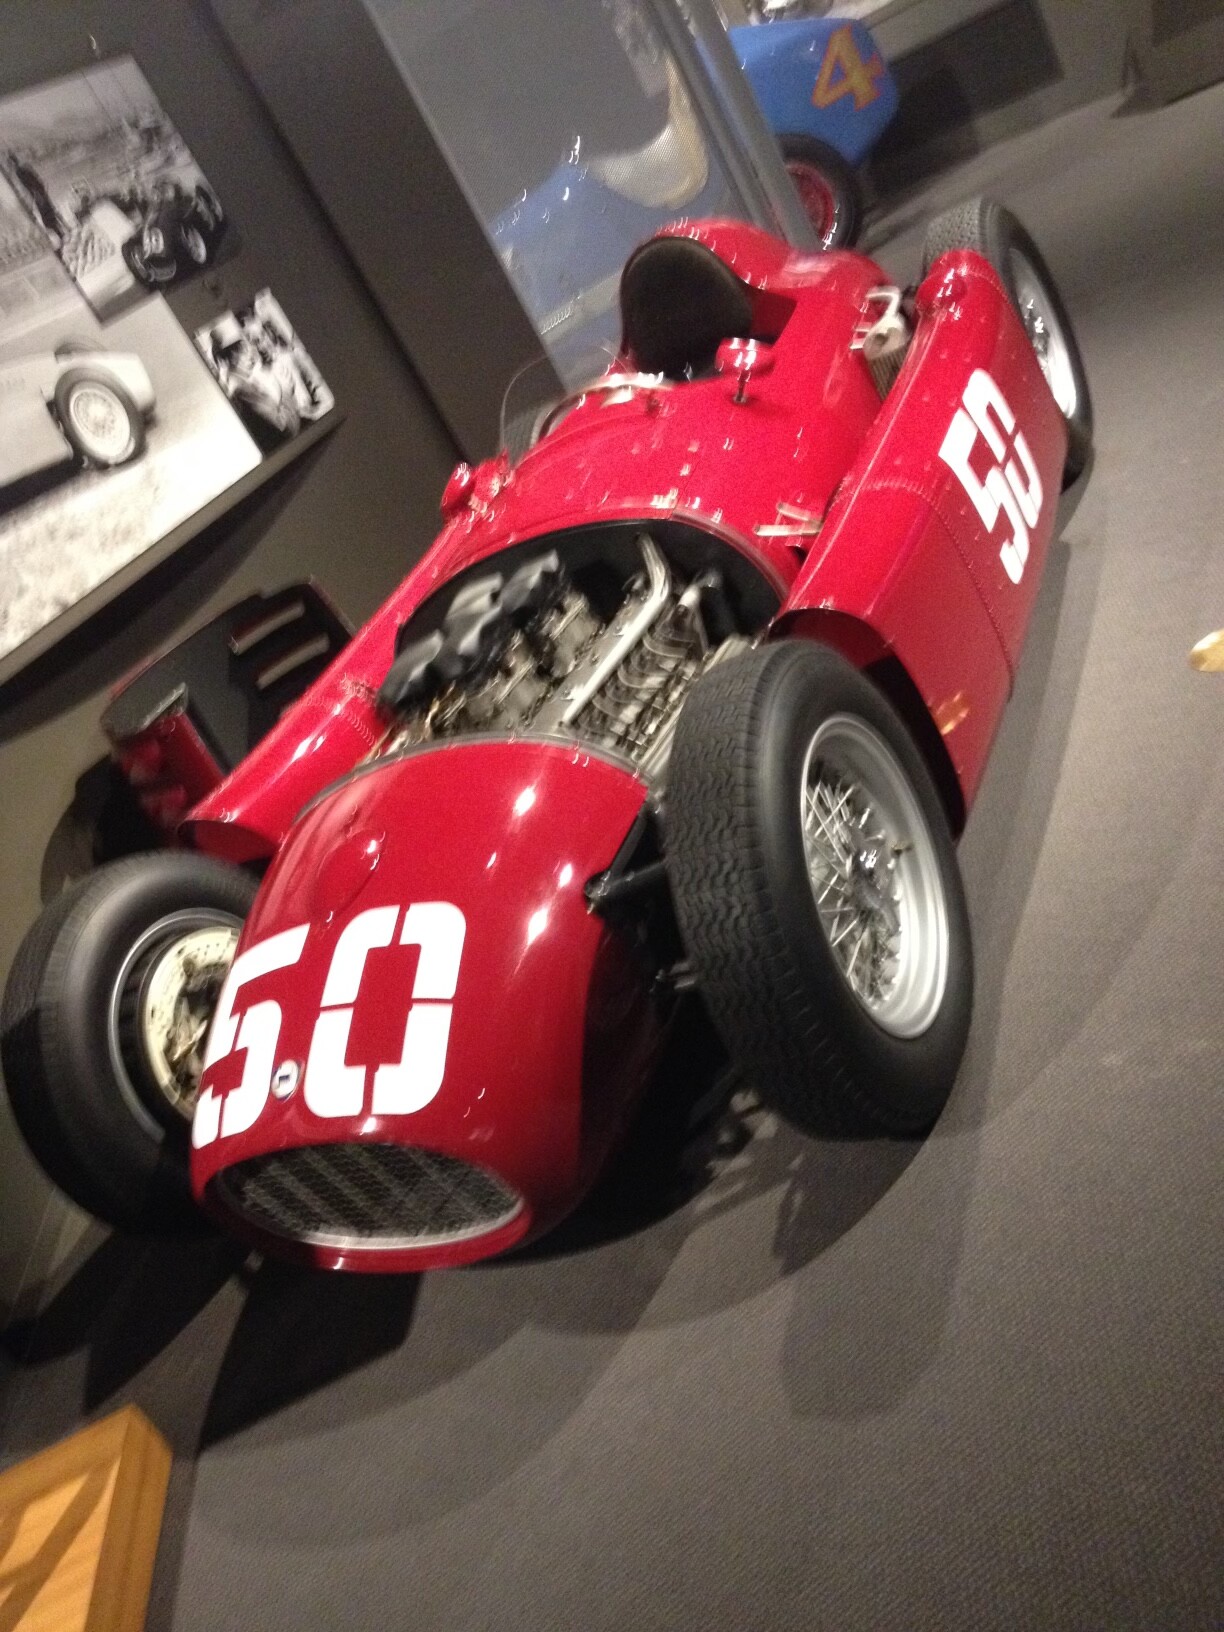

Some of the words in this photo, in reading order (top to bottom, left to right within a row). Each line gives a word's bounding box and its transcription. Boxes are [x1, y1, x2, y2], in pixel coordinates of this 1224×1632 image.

[810, 23, 884, 112] 4
[938, 368, 1043, 584] 50
[192, 901, 466, 1149] 50
